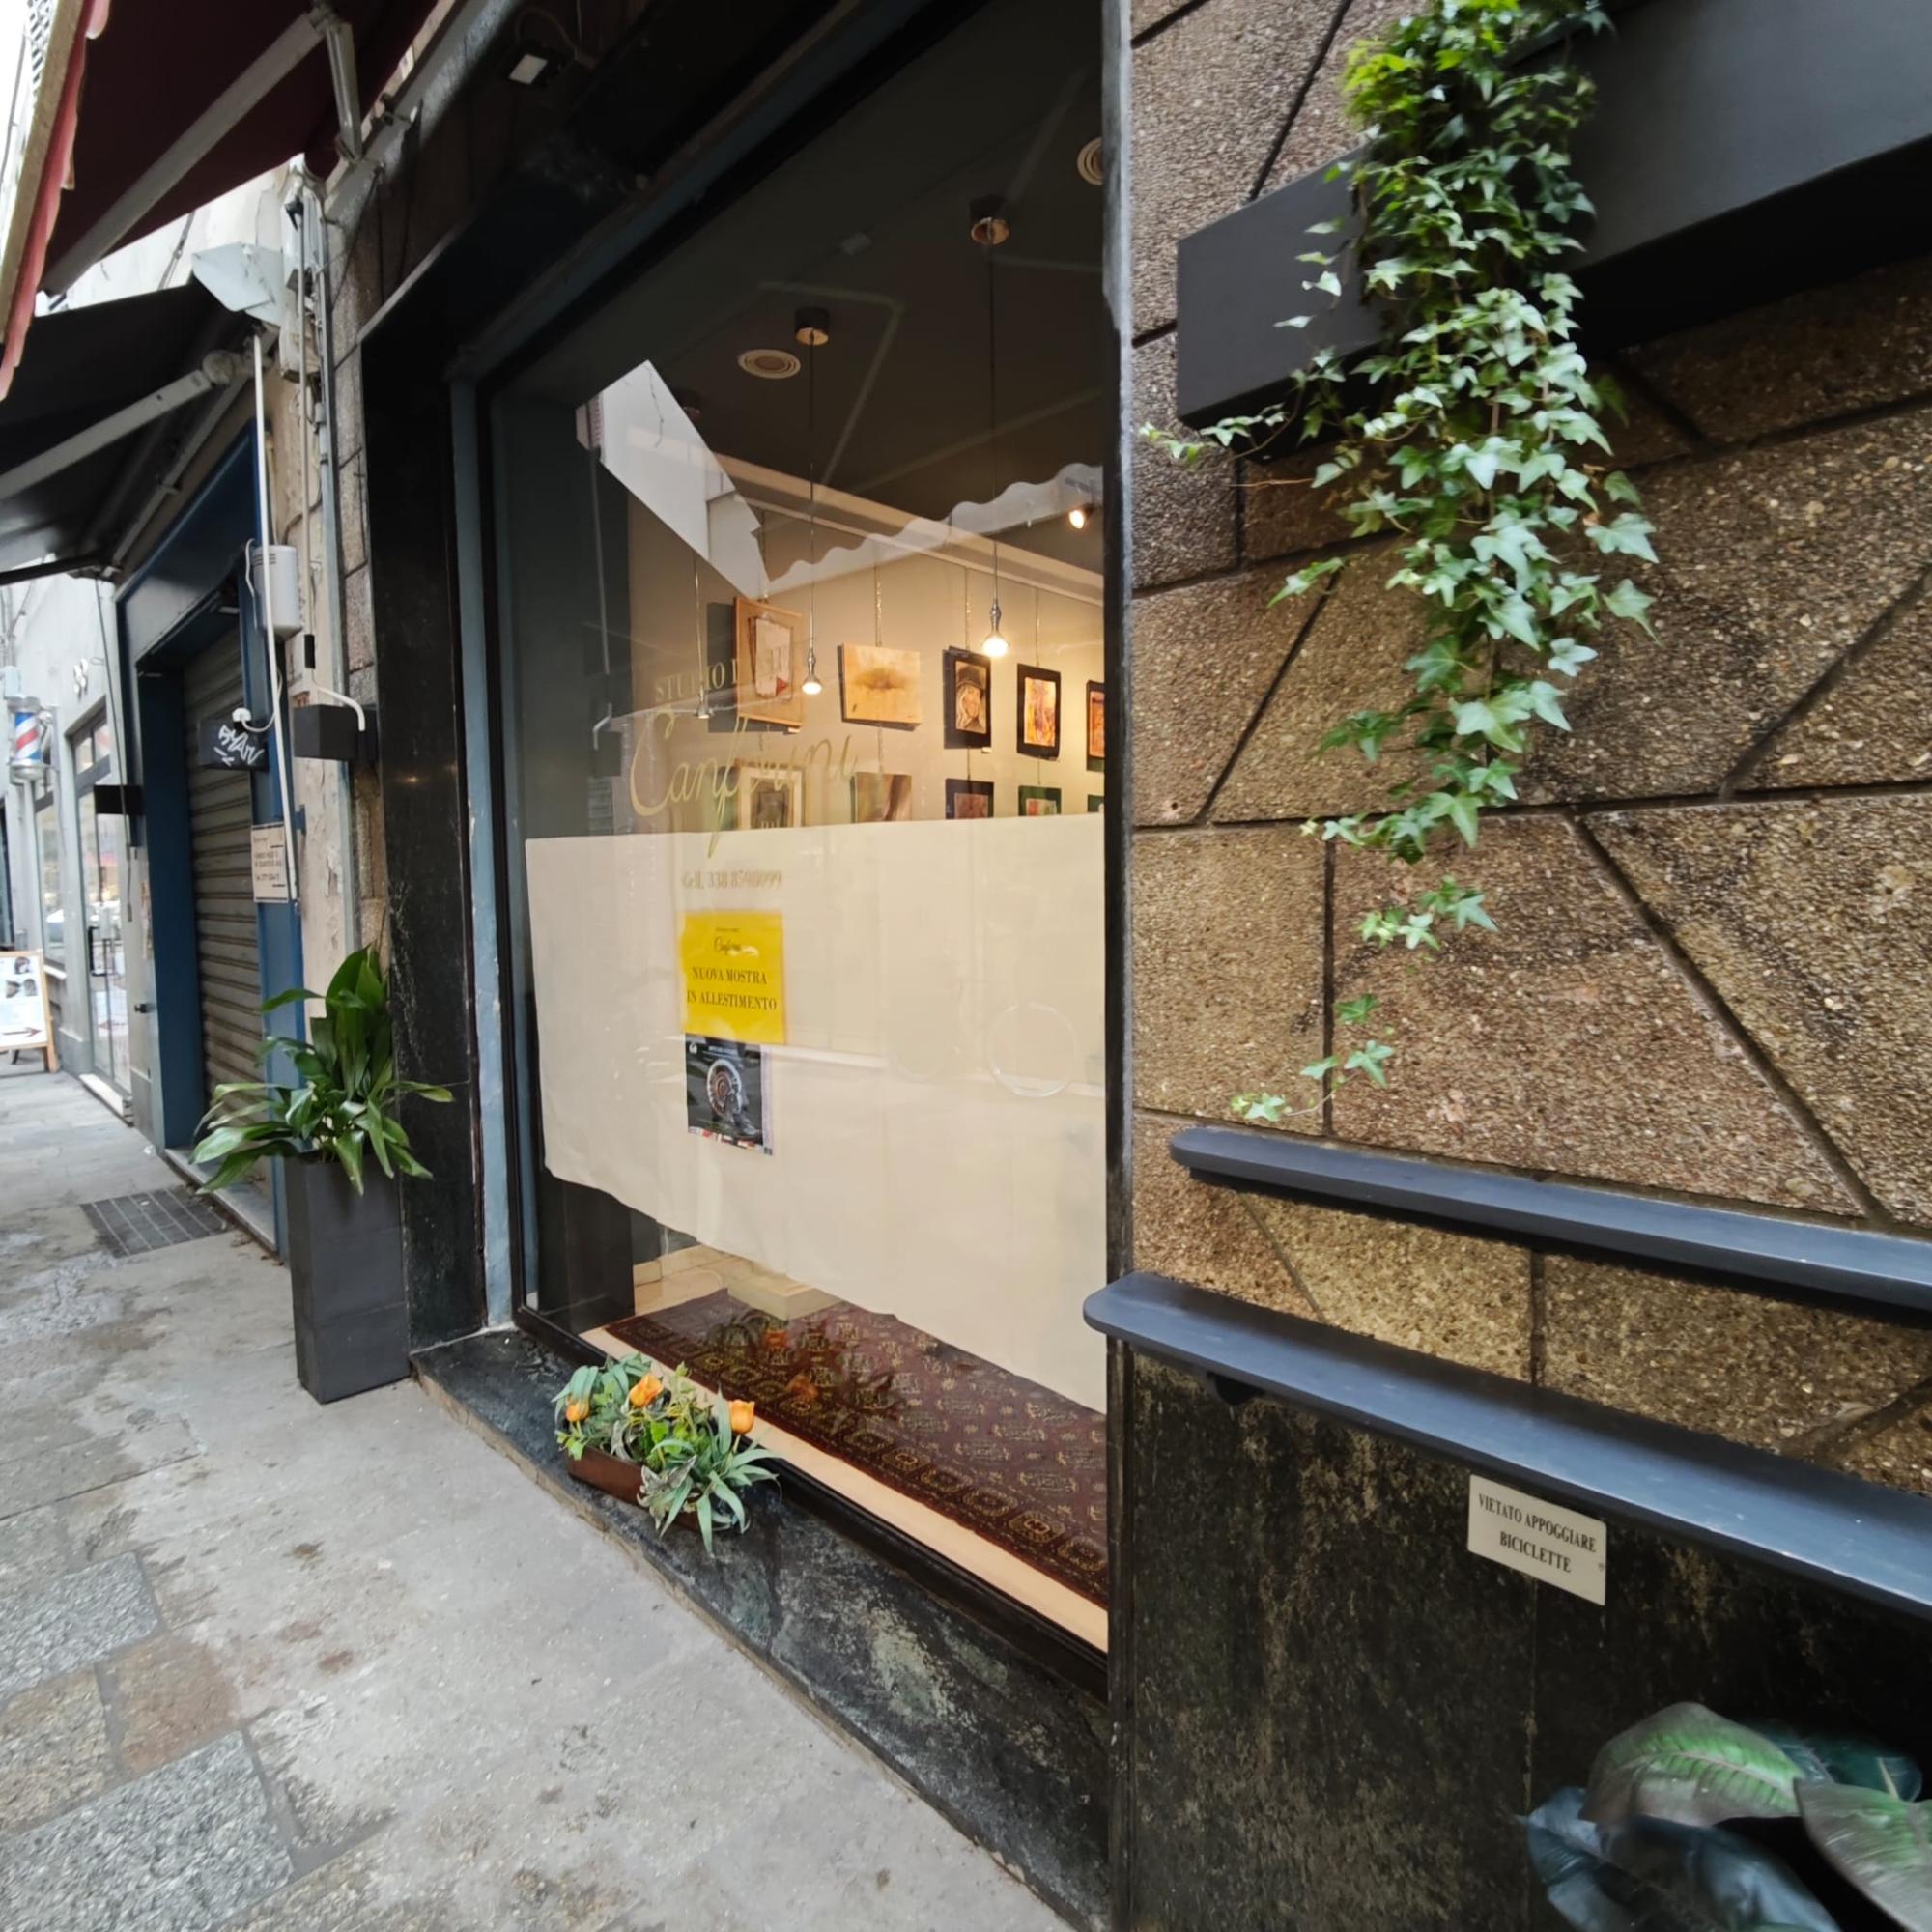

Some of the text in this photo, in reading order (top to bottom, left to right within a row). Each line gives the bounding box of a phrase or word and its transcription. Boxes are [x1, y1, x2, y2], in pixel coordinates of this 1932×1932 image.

[692, 966, 768, 985] NUOVA MOSTRA
[687, 989, 778, 1011] IN ALLESTIMENTO
[1478, 1493, 1597, 1553] VIETATO APPOGGIARE
[1499, 1530, 1572, 1574] BICICLETTE
